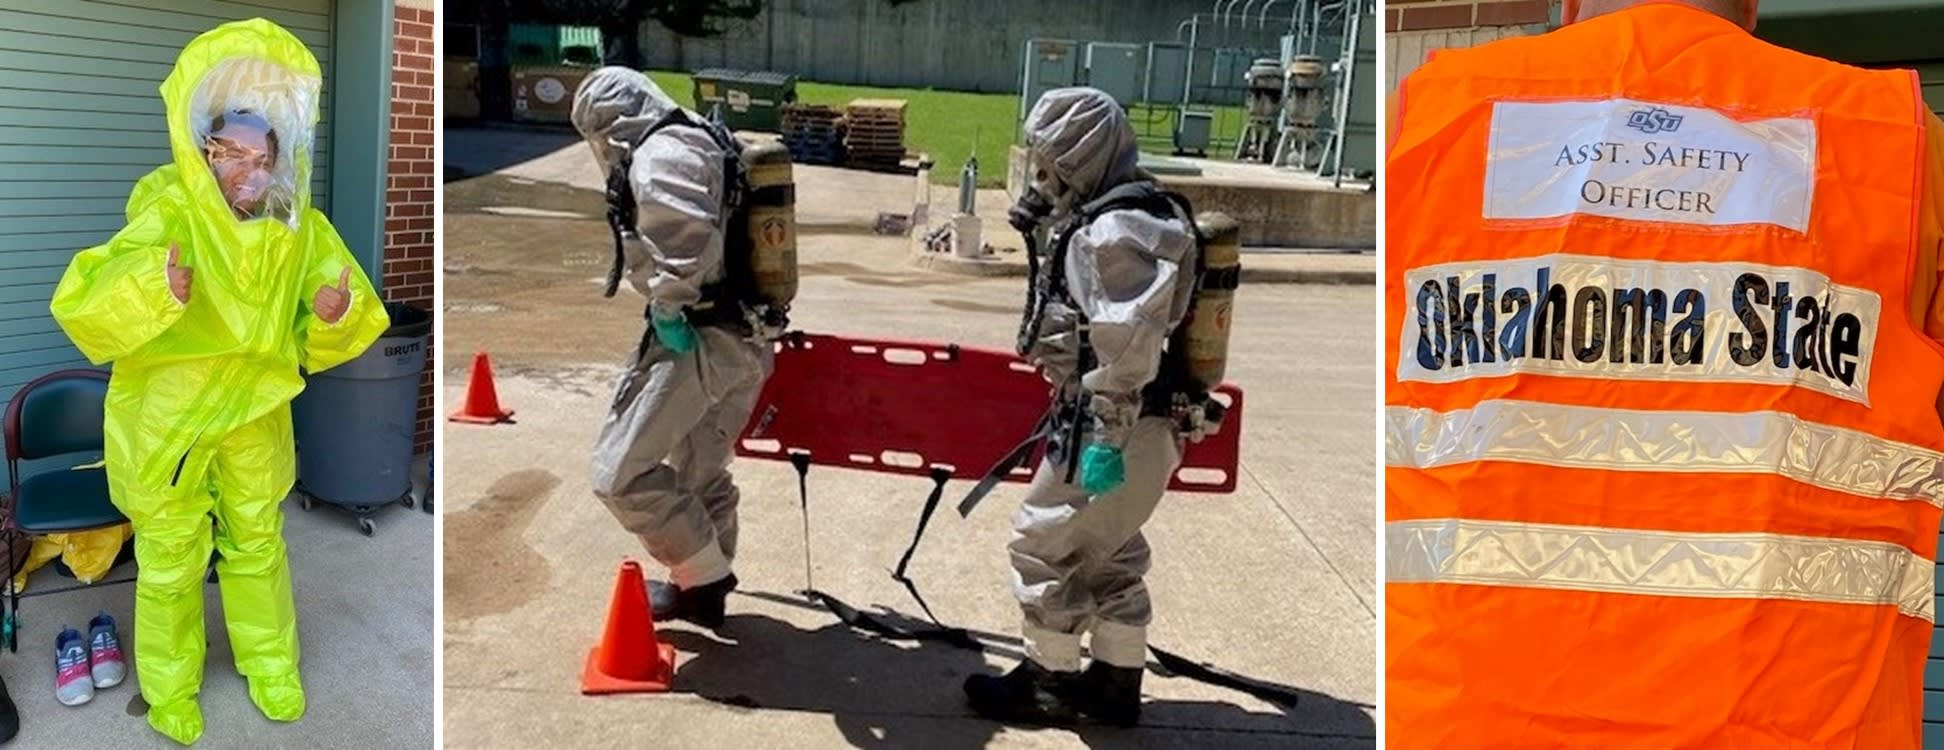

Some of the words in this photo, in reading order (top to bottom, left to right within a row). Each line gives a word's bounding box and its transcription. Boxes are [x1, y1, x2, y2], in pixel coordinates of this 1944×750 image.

[1627, 107, 1684, 133] OSU
[1642, 141, 1750, 172] SAFETY
[1580, 179, 1716, 214] OFFICER
[1415, 266, 1707, 372] Oklahoma
[1728, 272, 1862, 387] State
[384, 341, 421, 357] BRUTE
